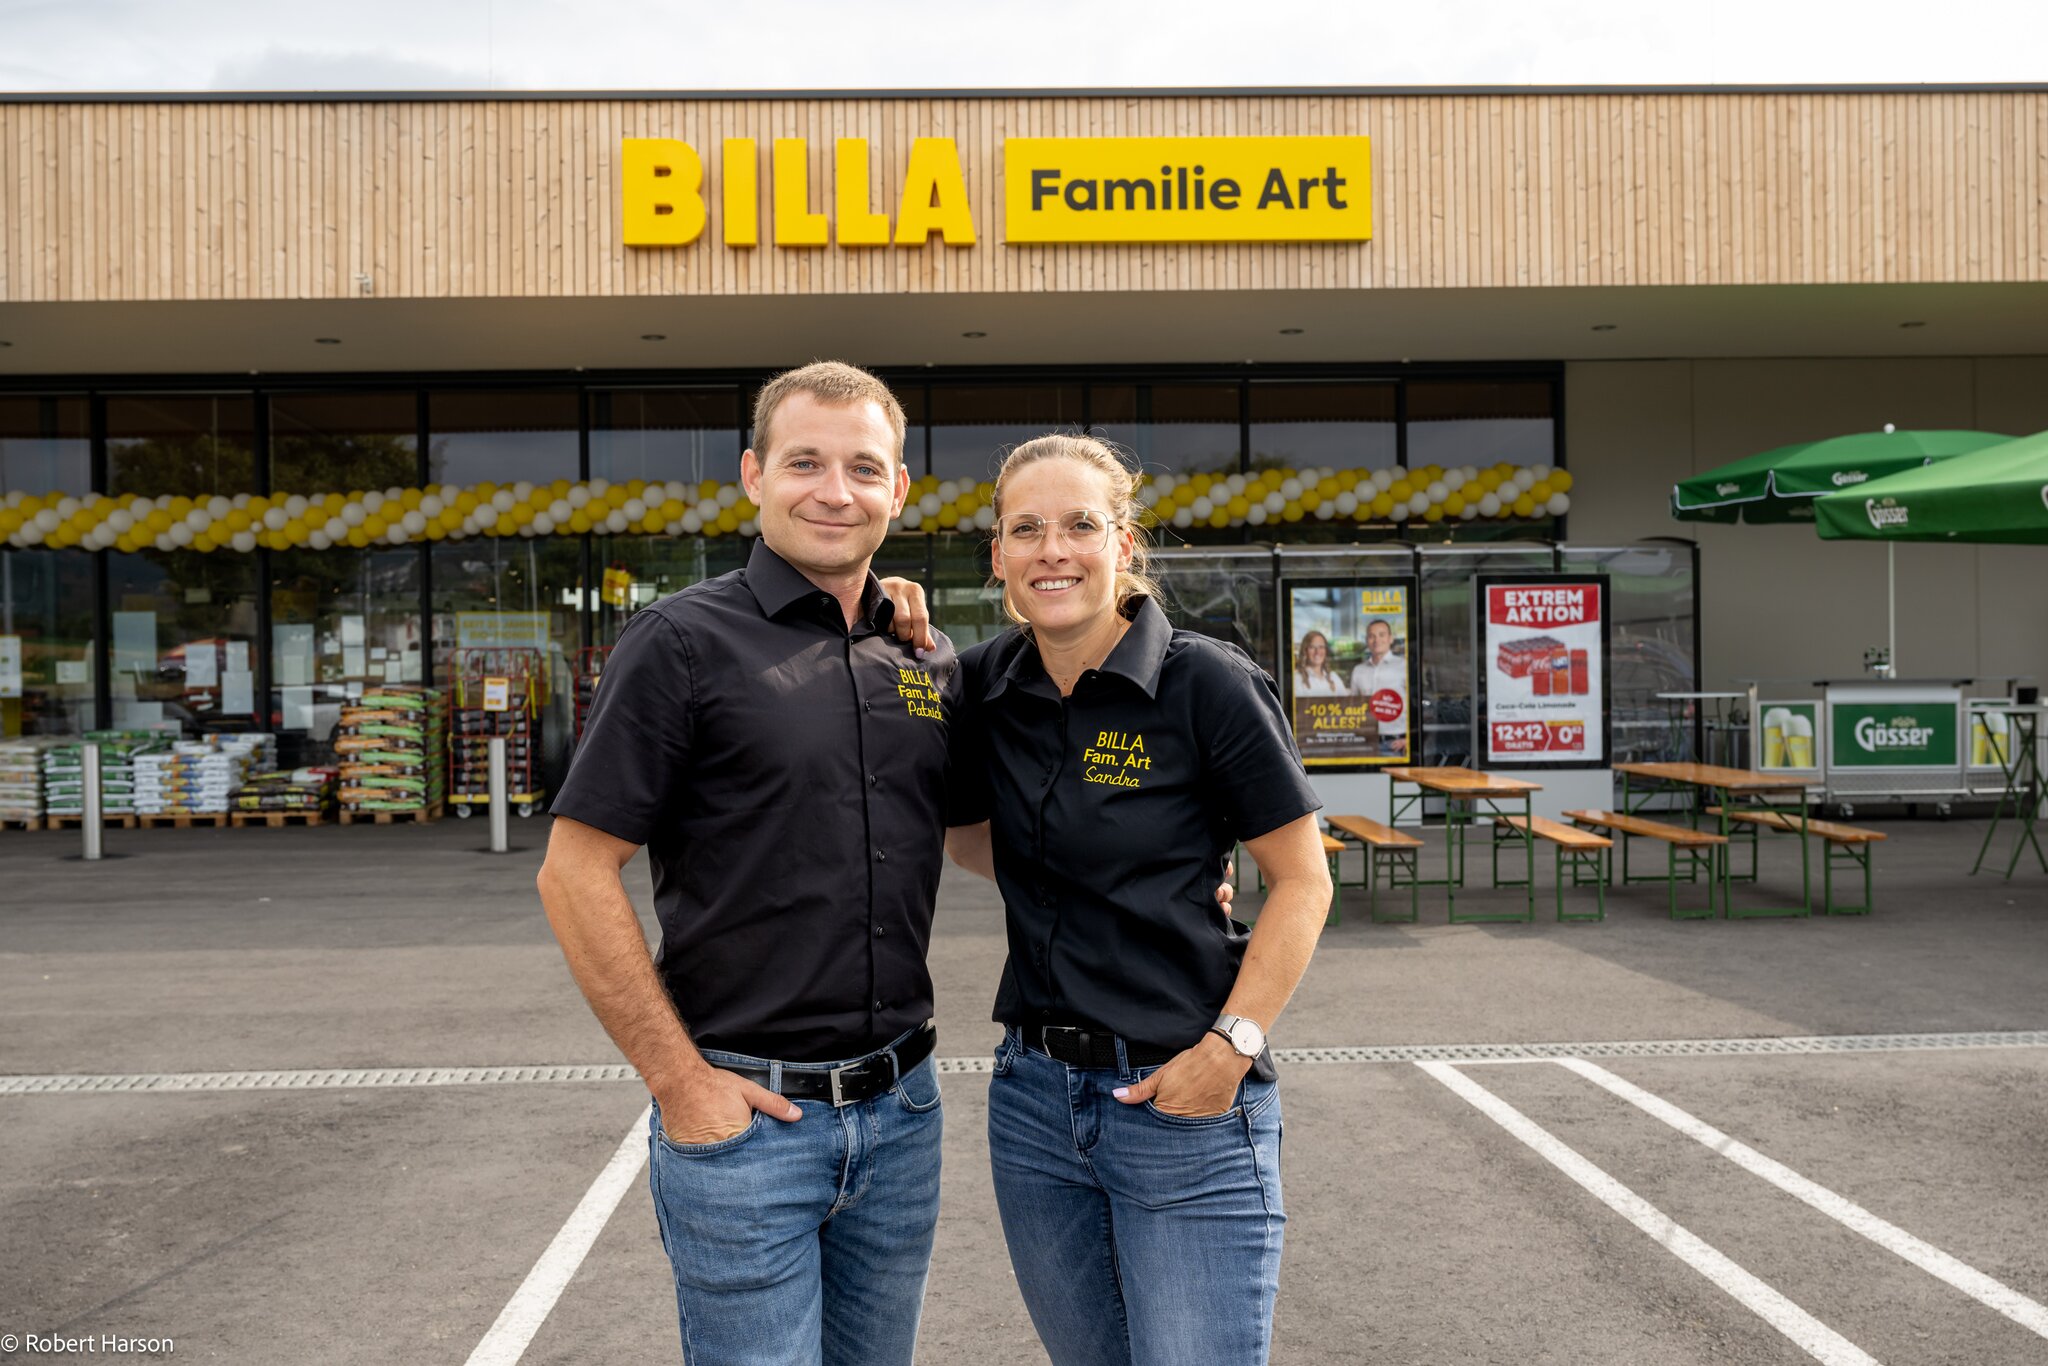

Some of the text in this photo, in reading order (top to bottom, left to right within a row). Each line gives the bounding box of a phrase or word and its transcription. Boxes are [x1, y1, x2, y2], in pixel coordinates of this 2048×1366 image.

[622, 137, 977, 247] BILLA
[1031, 165, 1348, 211] Familie Art
[1362, 591, 1402, 603] BILLA
[1504, 589, 1584, 607] EXTREM
[1505, 605, 1584, 622] AKTION
[899, 668, 933, 688] BILLA
[1344, 703, 1368, 715] auf
[1096, 731, 1145, 753] BILLA
[1496, 724, 1543, 741] 12+12
[1855, 716, 1934, 752] Gösser
[1083, 748, 1152, 770] Fam. Art
[1083, 765, 1140, 788] Sandra
